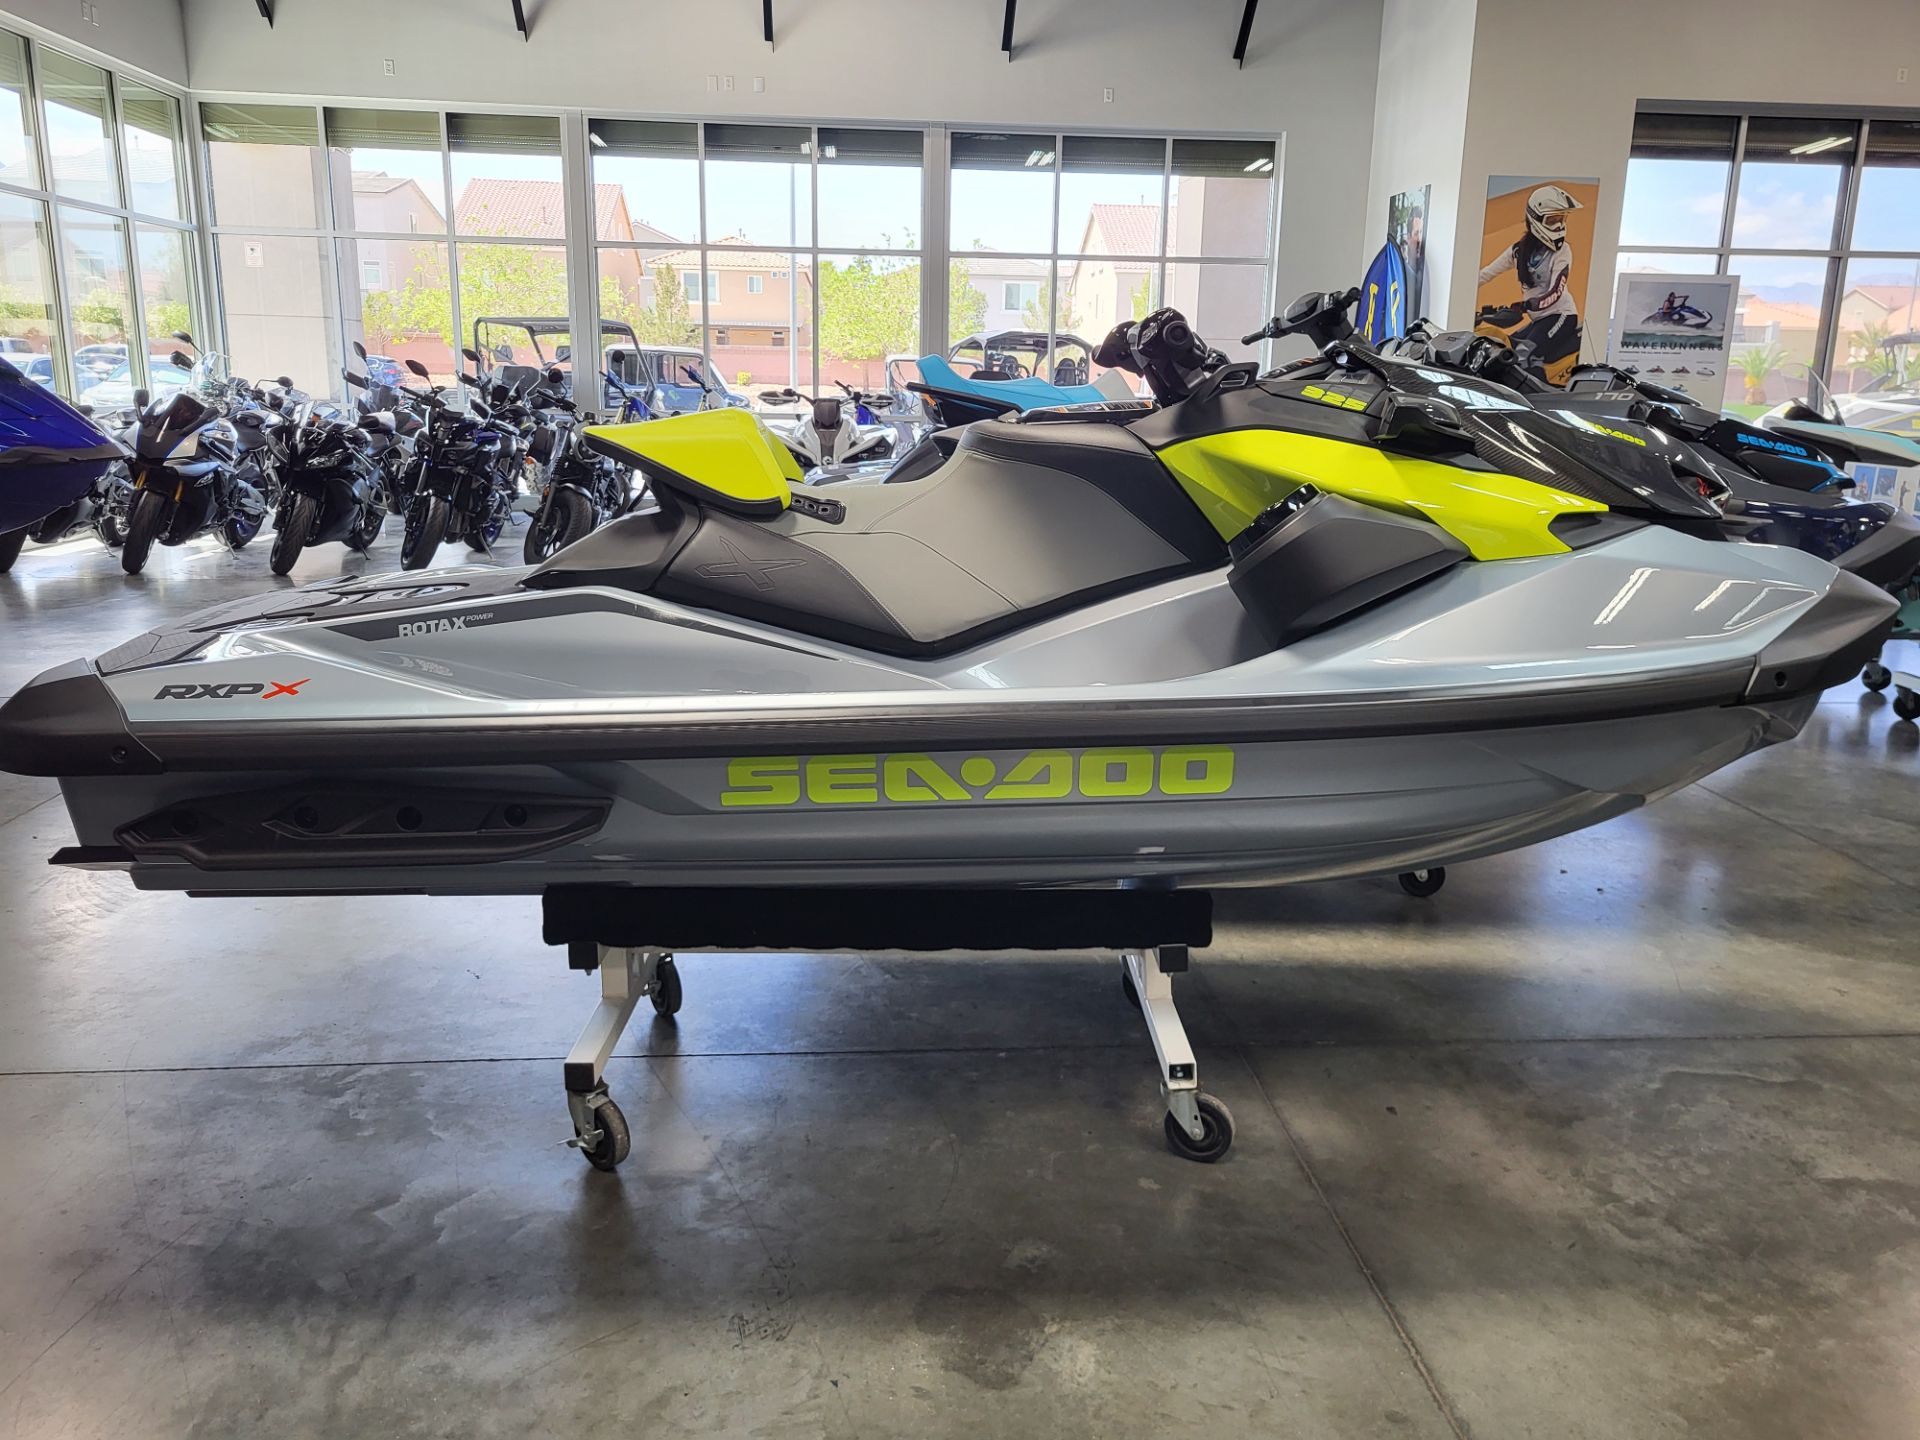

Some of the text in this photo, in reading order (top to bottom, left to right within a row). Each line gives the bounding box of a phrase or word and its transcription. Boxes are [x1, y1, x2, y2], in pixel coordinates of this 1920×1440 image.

[1620, 340, 1724, 351] WAVERUNNERS
[1594, 392, 1635, 401] 170
[398, 612, 494, 639] ROTAX POWER
